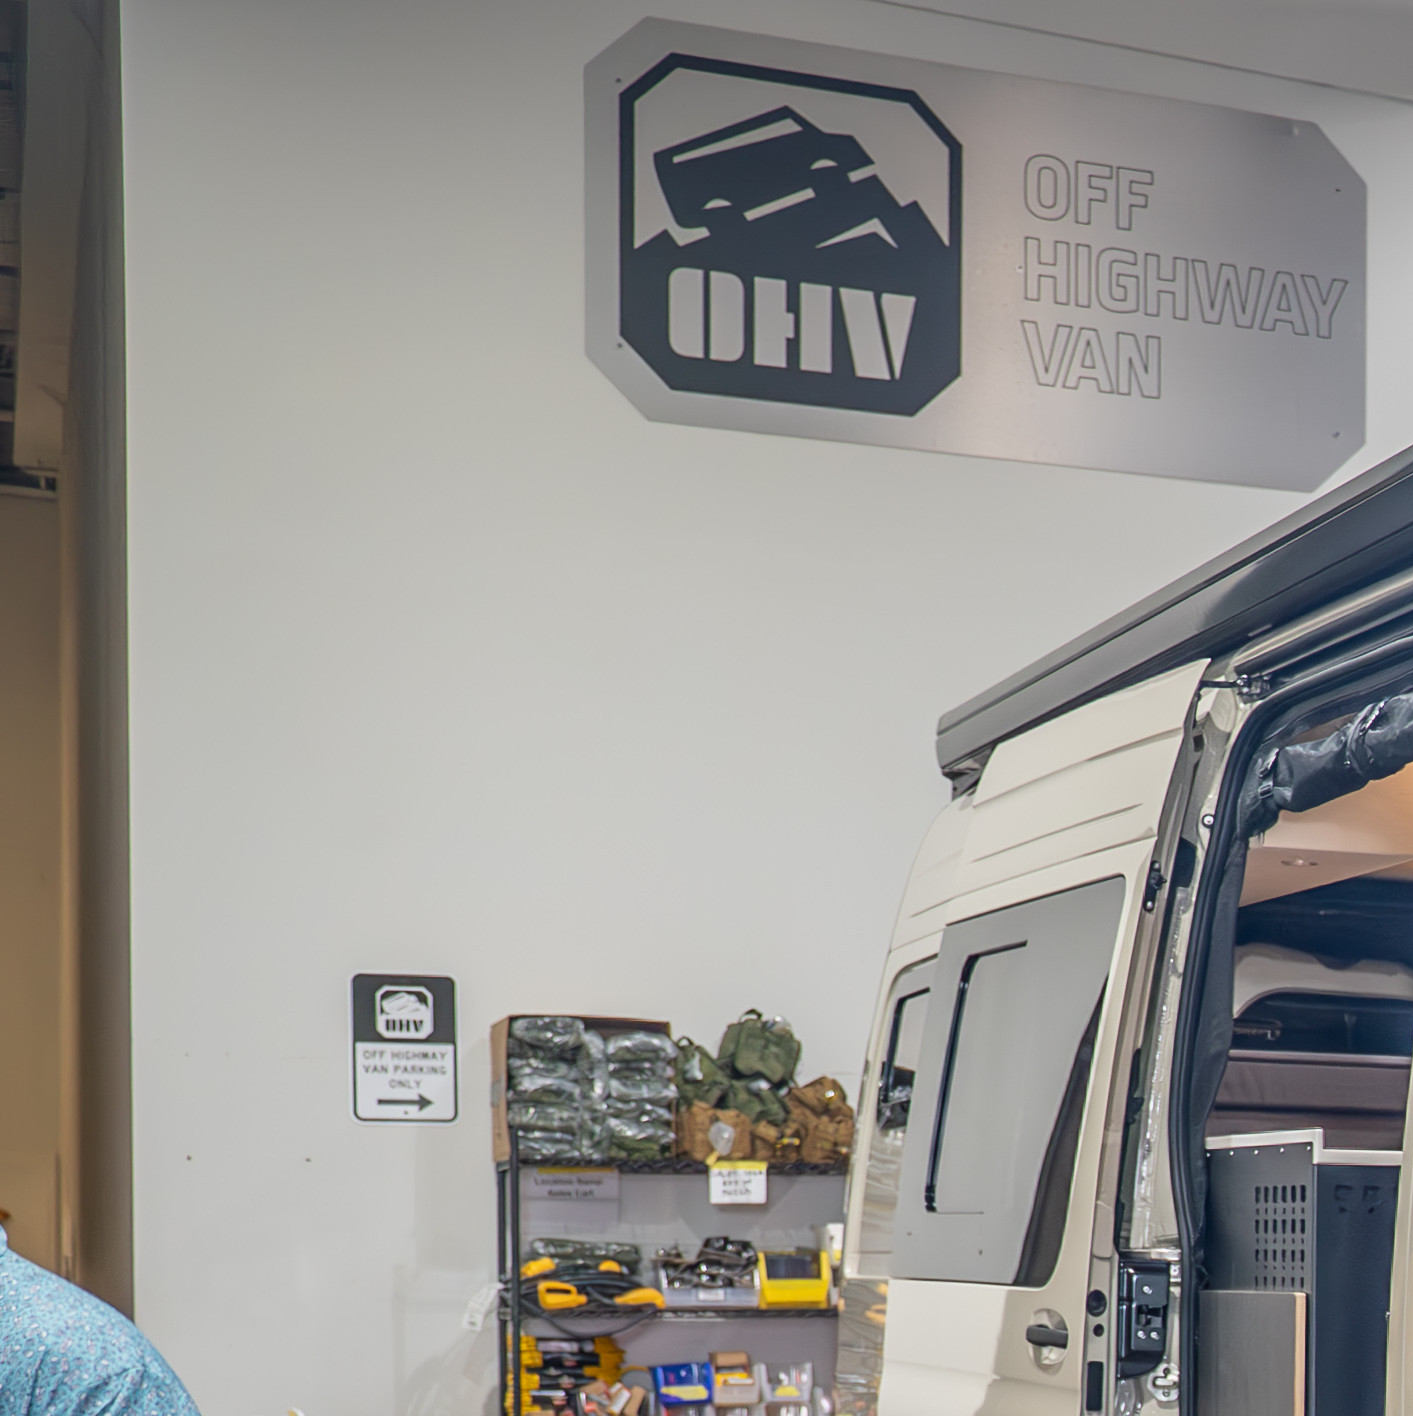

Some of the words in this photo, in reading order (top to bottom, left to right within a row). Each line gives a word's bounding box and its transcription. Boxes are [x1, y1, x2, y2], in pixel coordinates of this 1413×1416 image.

[1023, 154, 1155, 231] OFF
[667, 266, 917, 381] OHV
[1023, 236, 1349, 340] HIGHWAY
[1020, 319, 1162, 399] VAN
[362, 1050, 387, 1061] OFF
[391, 1050, 448, 1062] HIGHWAY
[362, 1063, 389, 1074] VAN
[393, 1064, 448, 1076] PARKING
[388, 1078, 423, 1089] ONLY
